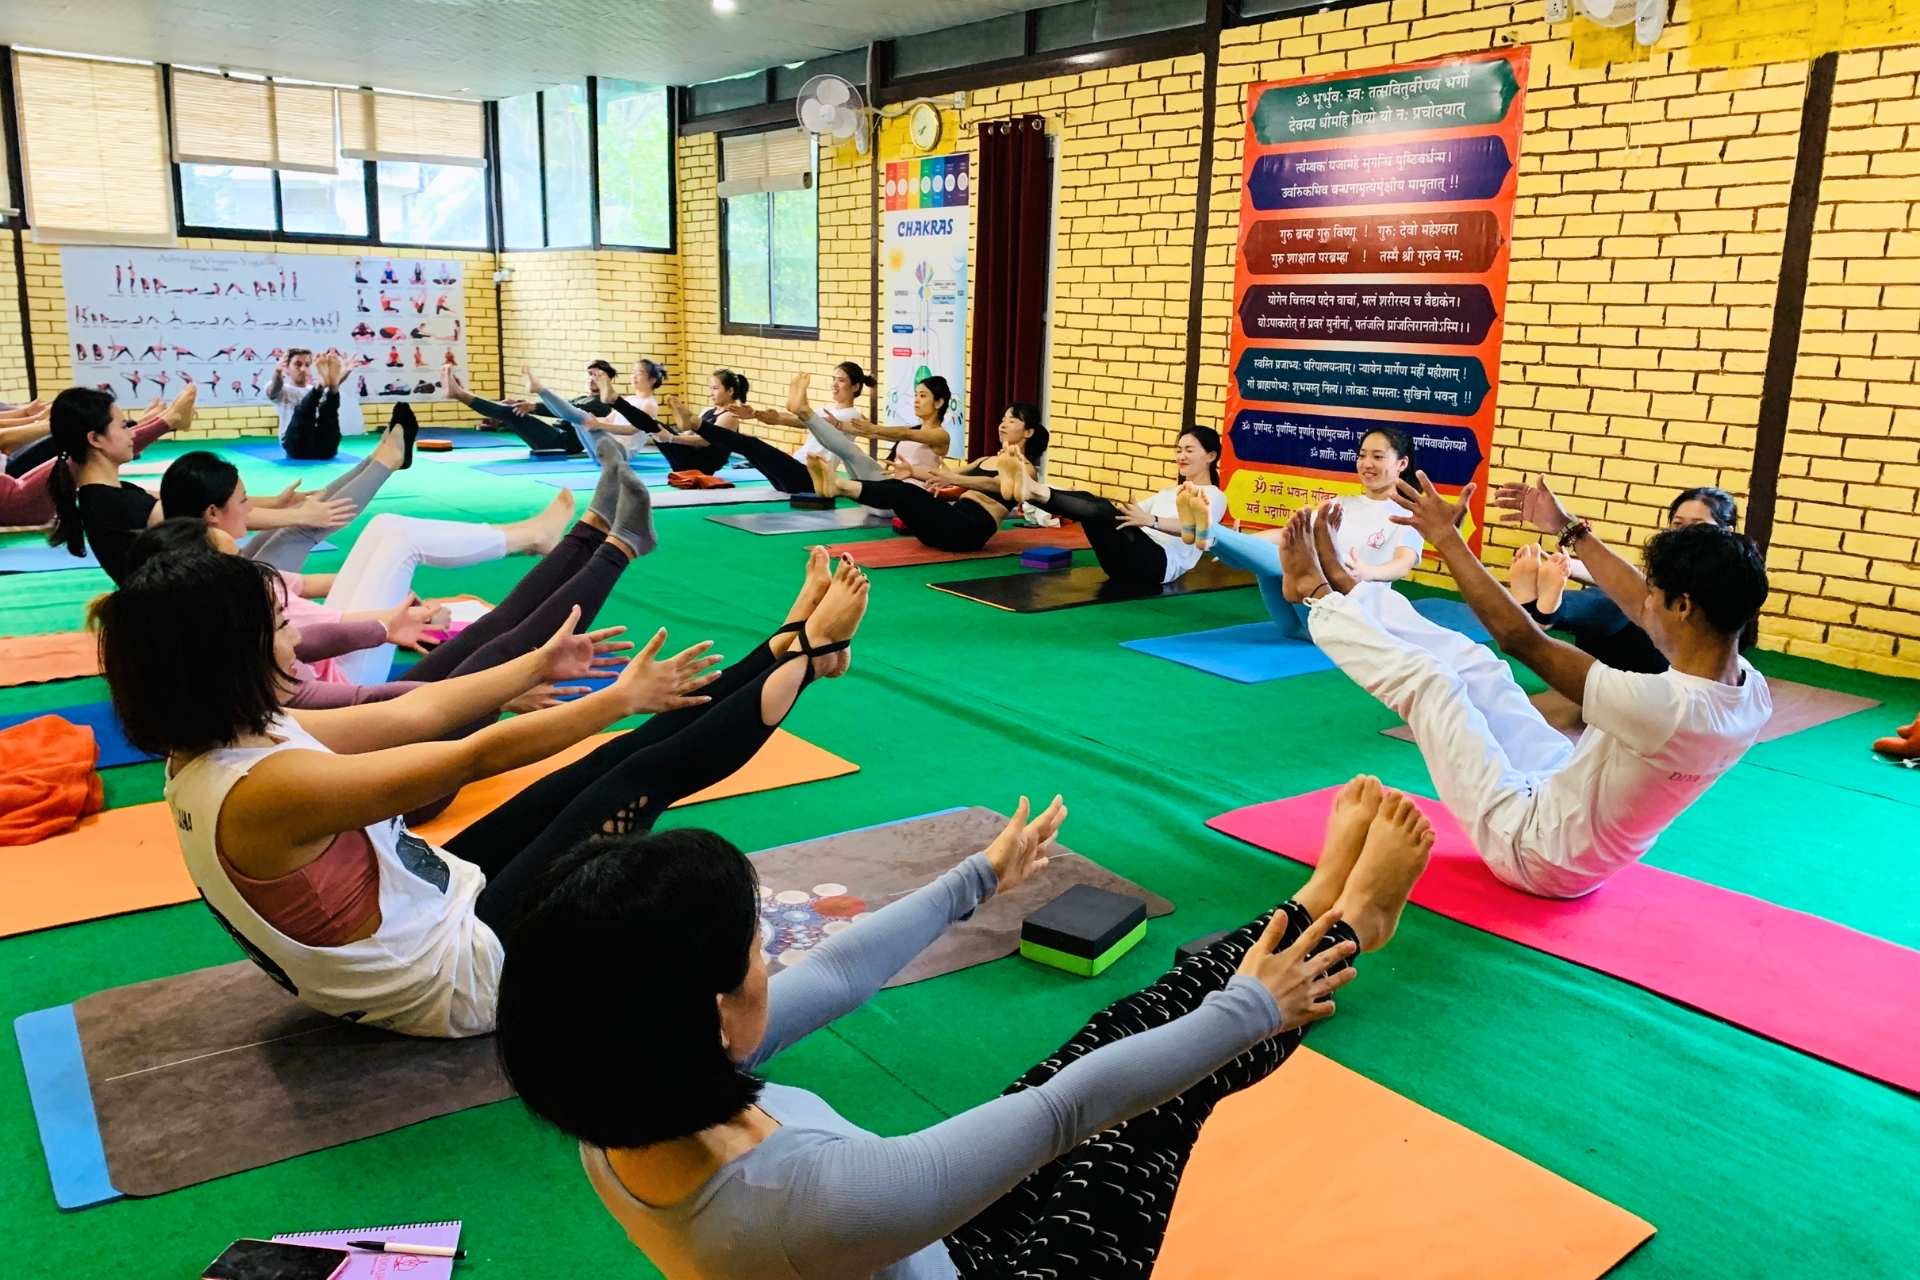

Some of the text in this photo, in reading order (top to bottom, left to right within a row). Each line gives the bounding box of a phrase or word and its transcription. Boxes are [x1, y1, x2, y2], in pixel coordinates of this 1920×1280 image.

[1296, 92, 1310, 107] ॐ
[1288, 116, 1316, 134] देवस्य
[1319, 111, 1348, 129] धीमहि
[1412, 100, 1467, 120] प्रचोदयात्
[898, 218, 953, 237] CHAKRAS
[1280, 229, 1294, 245] गुरु
[1400, 221, 1417, 237] देवो
[1271, 253, 1285, 268] गुरु
[1402, 246, 1414, 262] श्री
[1268, 292, 1287, 306] योगेन
[1318, 292, 1335, 306] पदेन
[1380, 293, 1410, 307] शरीरस्य
[1414, 296, 1421, 307] च
[1403, 386, 1431, 403] सुखिनो
